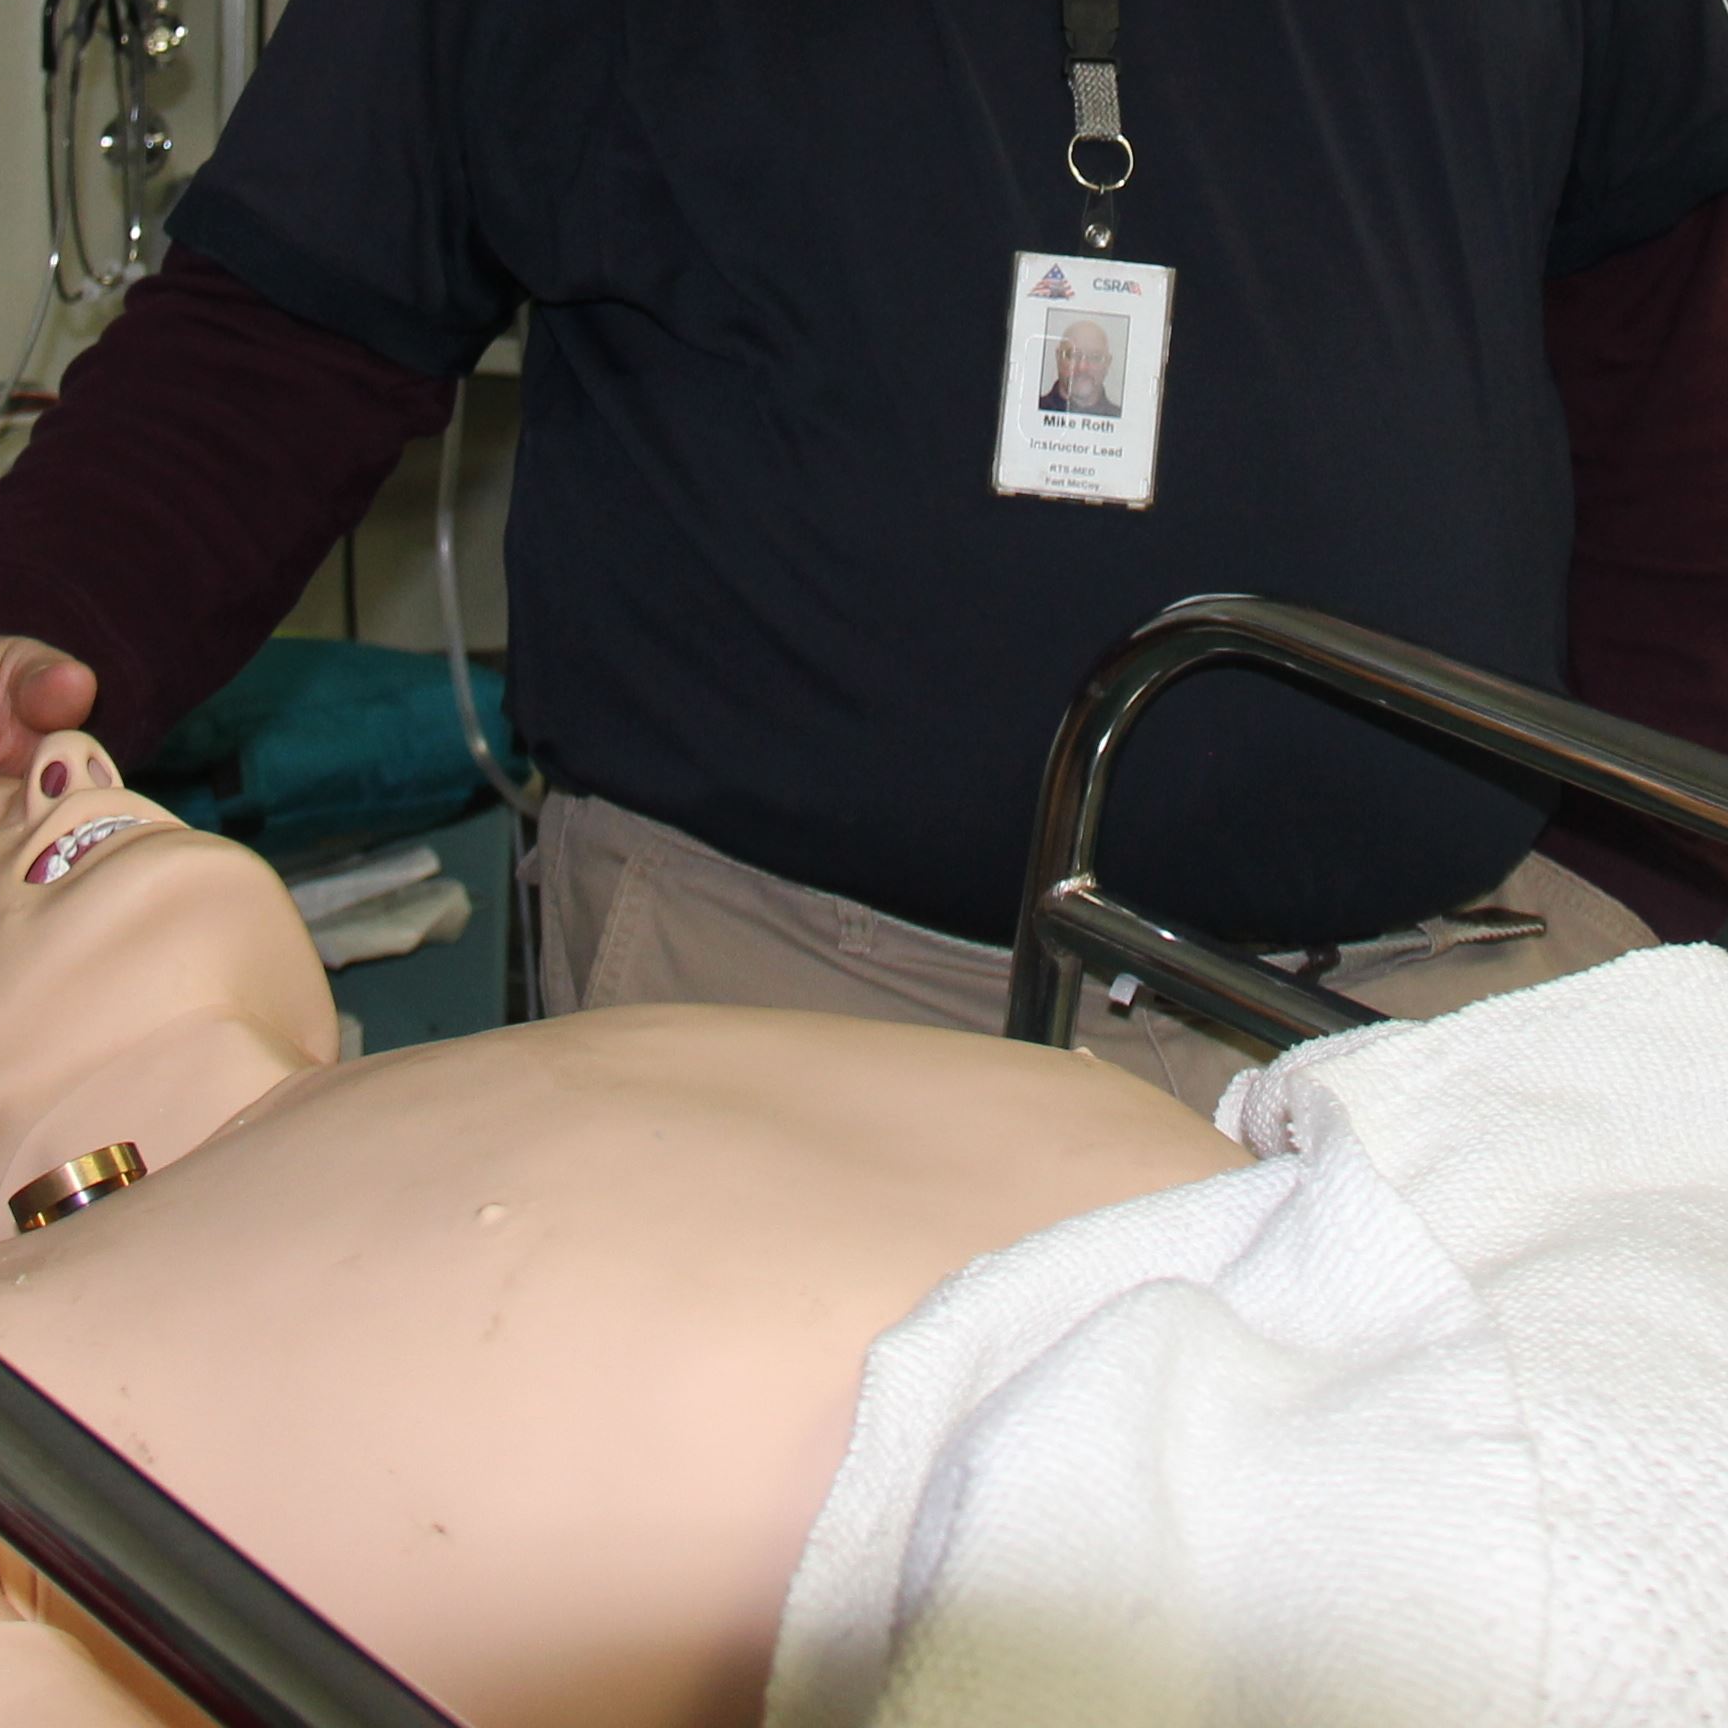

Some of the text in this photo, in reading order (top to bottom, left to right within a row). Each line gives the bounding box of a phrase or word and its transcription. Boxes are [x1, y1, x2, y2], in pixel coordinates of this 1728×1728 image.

[1092, 277, 1130, 293] CSRA
[1043, 415, 1114, 432] Mike Roth
[1030, 438, 1123, 458] Instructor Lead
